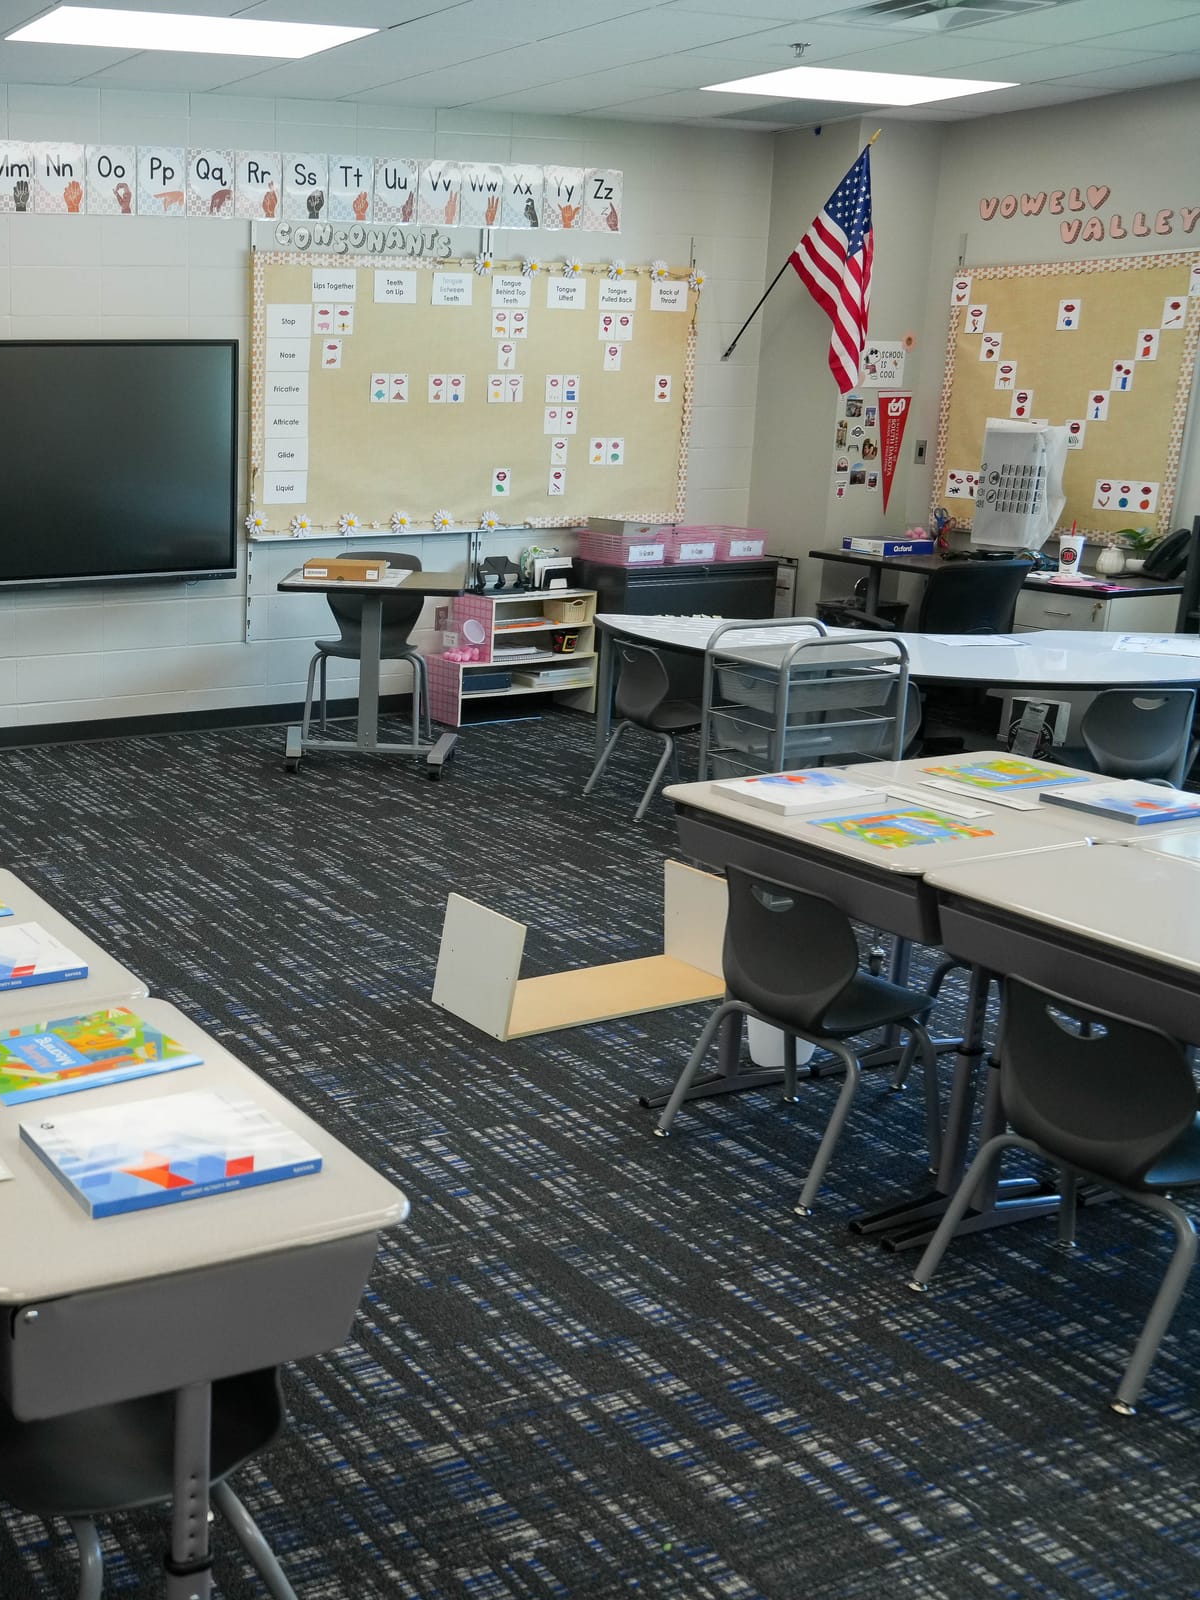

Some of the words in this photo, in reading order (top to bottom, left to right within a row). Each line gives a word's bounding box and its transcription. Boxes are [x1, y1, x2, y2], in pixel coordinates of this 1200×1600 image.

[46, 153, 73, 178] Nn
[97, 155, 126, 179] Oo
[150, 157, 175, 186] Pp
[196, 157, 228, 187] Qq
[247, 161, 271, 185] Rr
[294, 163, 318, 186] Ss
[340, 165, 363, 188] Tt
[385, 167, 408, 191] Uu
[429, 170, 451, 192] Vv
[469, 172, 498, 194] Ww
[513, 174, 533, 196] Xx
[554, 176, 574, 201] Yy
[593, 179, 614, 200] Zz
[979, 187, 1085, 221] VOWEL
[1060, 207, 1200, 244] VALLEY
[275, 222, 452, 258] CONSONANTS
[313, 282, 326, 290] Lips
[327, 282, 354, 290] Together
[395, 288, 404, 296] Lip
[556, 286, 577, 294] Tongue
[281, 318, 296, 326] Stop
[881, 351, 904, 359] SCHOOL
[881, 361, 887, 369] IS
[880, 371, 896, 379] COOL
[889, 418, 897, 444] SOUTH
[886, 446, 894, 476] DAKOTA
[276, 485, 294, 493] Liquid
[34, 1036, 76, 1066] Meaning
